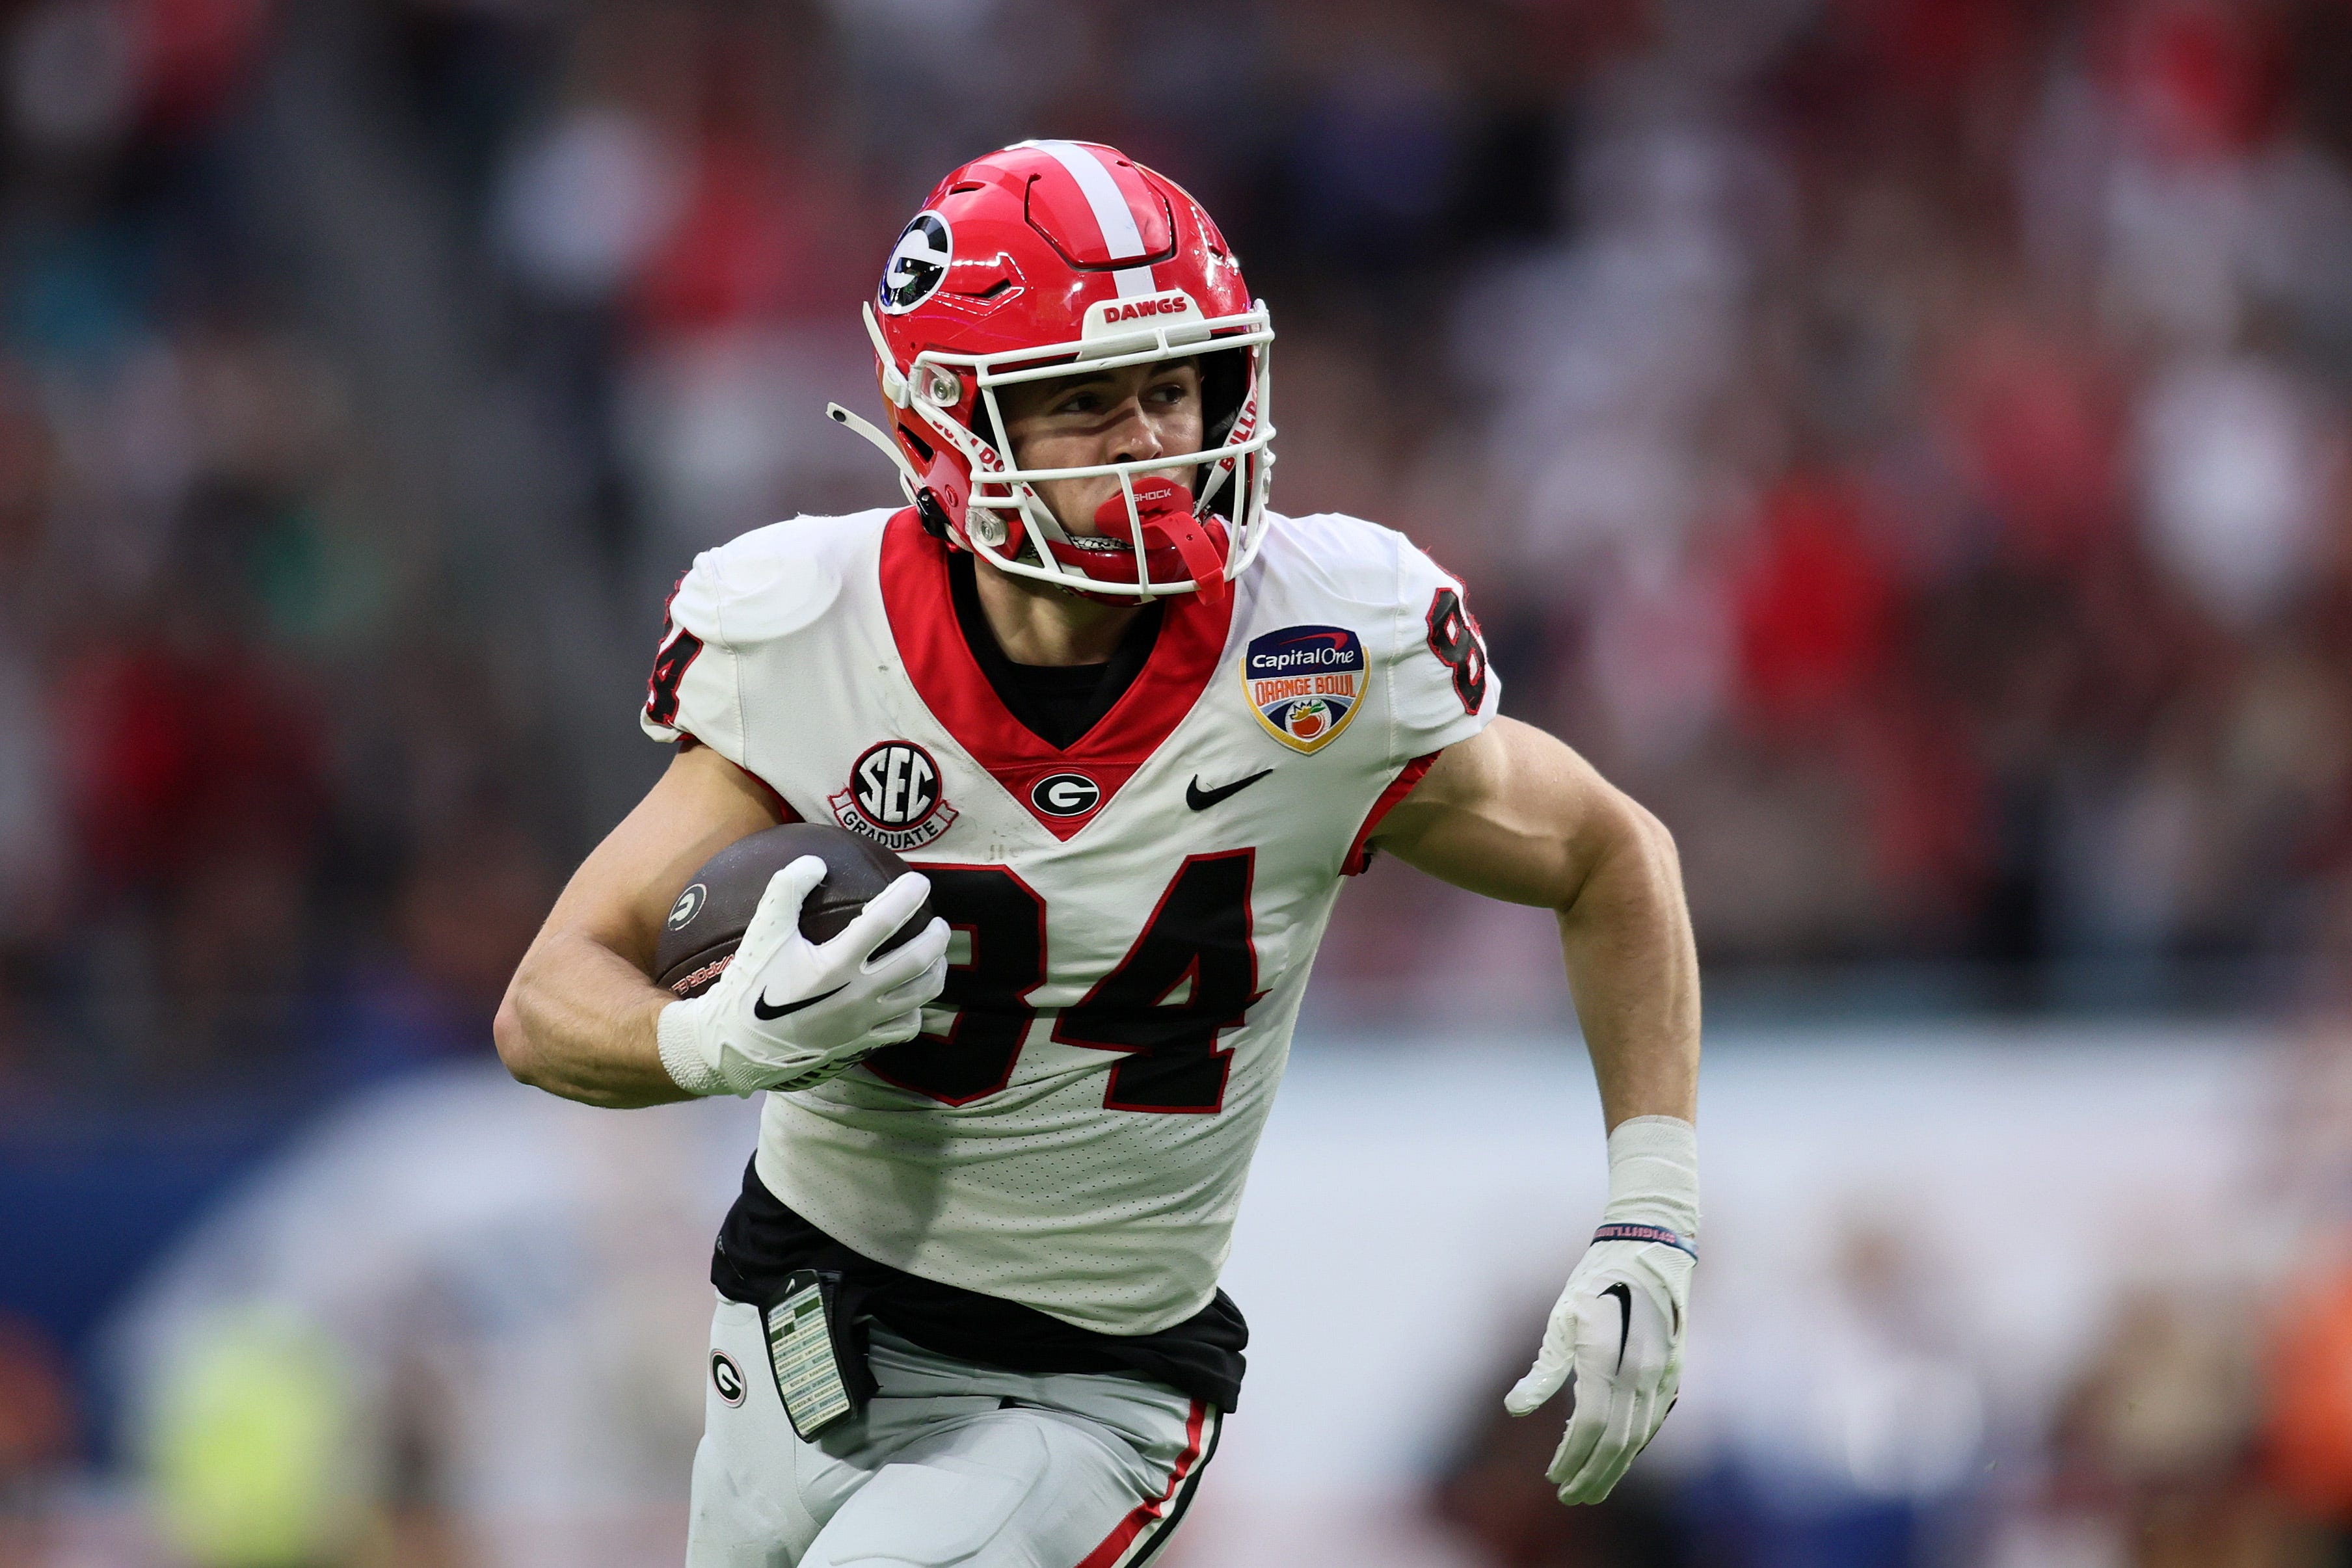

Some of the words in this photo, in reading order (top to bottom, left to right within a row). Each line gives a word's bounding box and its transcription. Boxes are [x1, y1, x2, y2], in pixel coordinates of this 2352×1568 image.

[1102, 296, 1188, 324] DAWGS
[1133, 488, 1171, 502] SHOCK
[1255, 676, 1312, 707] ORANGE
[1315, 674, 1356, 698] BOWL
[859, 747, 934, 823] SEC
[843, 811, 939, 849] GRADUATE
